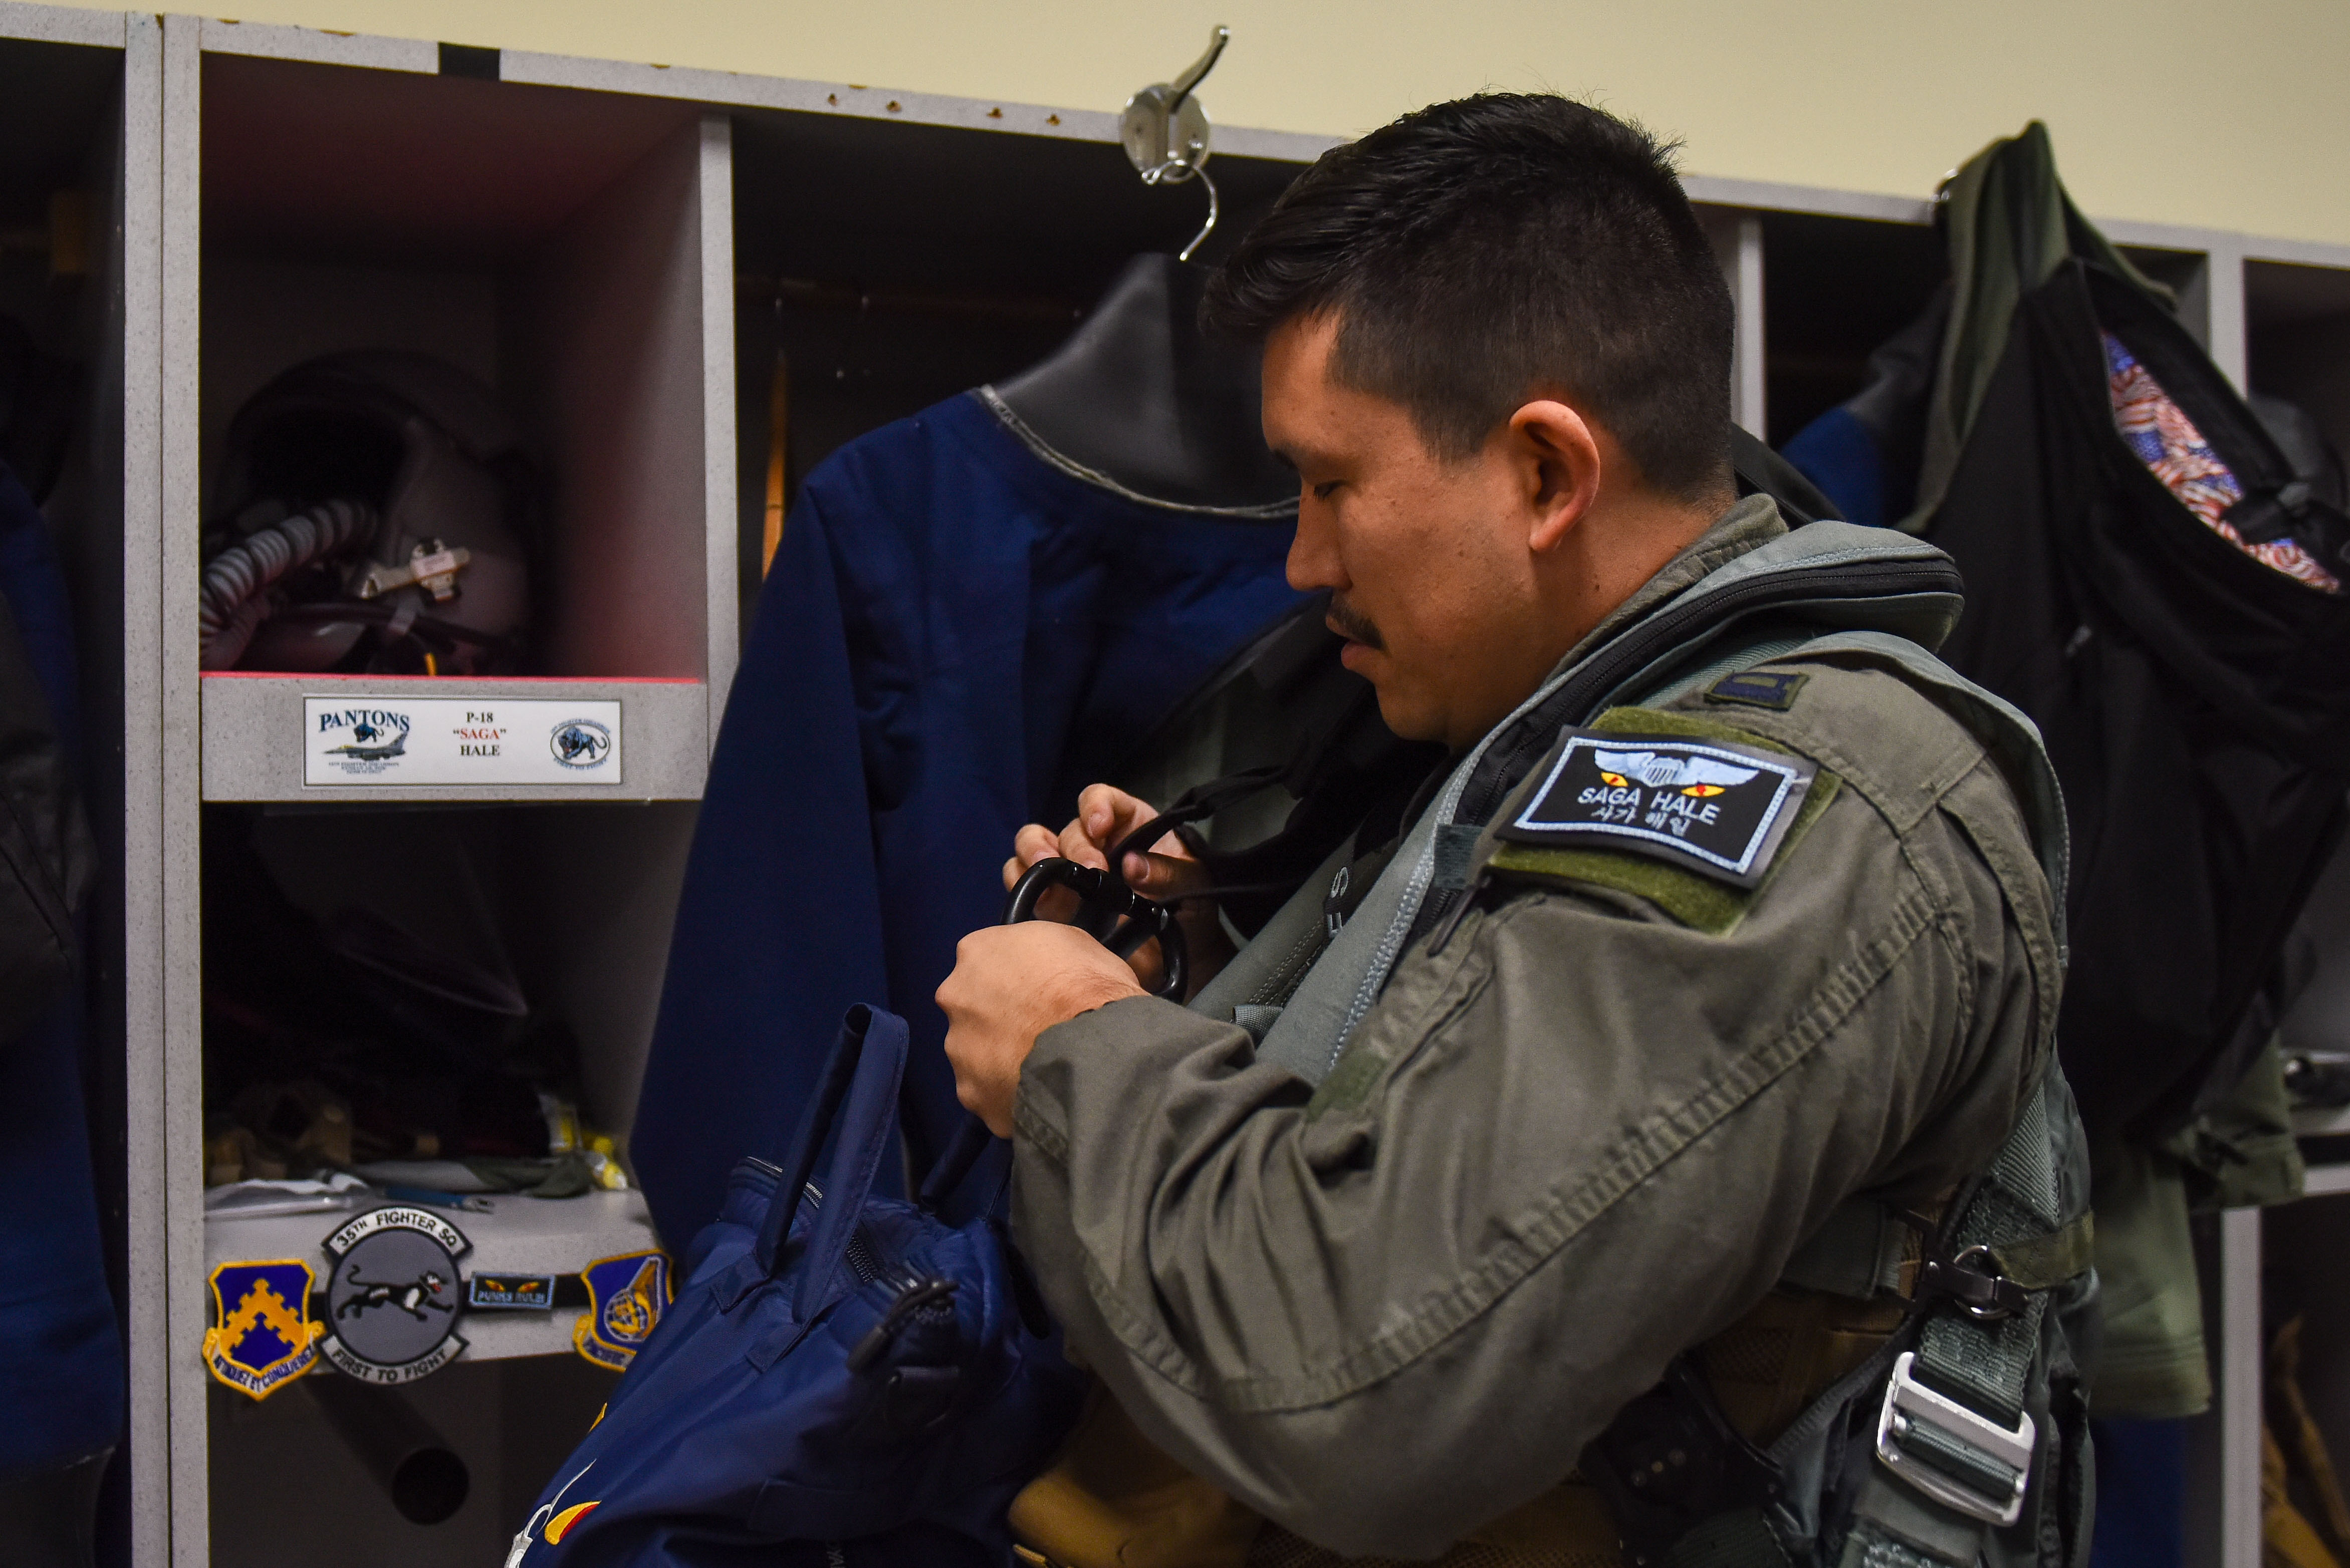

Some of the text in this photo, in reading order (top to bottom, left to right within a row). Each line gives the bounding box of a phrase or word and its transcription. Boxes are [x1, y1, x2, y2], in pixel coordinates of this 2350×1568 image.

[319, 709, 410, 732] PANTONS
[466, 712, 494, 723] P-18
[460, 744, 500, 757] HALE
[1577, 787, 1721, 826] SAGA HALE
[376, 1210, 437, 1232] FIGHTER
[331, 1348, 371, 1379] FIRST
[378, 1369, 398, 1383] TO
[404, 1347, 448, 1379] FIGHT
